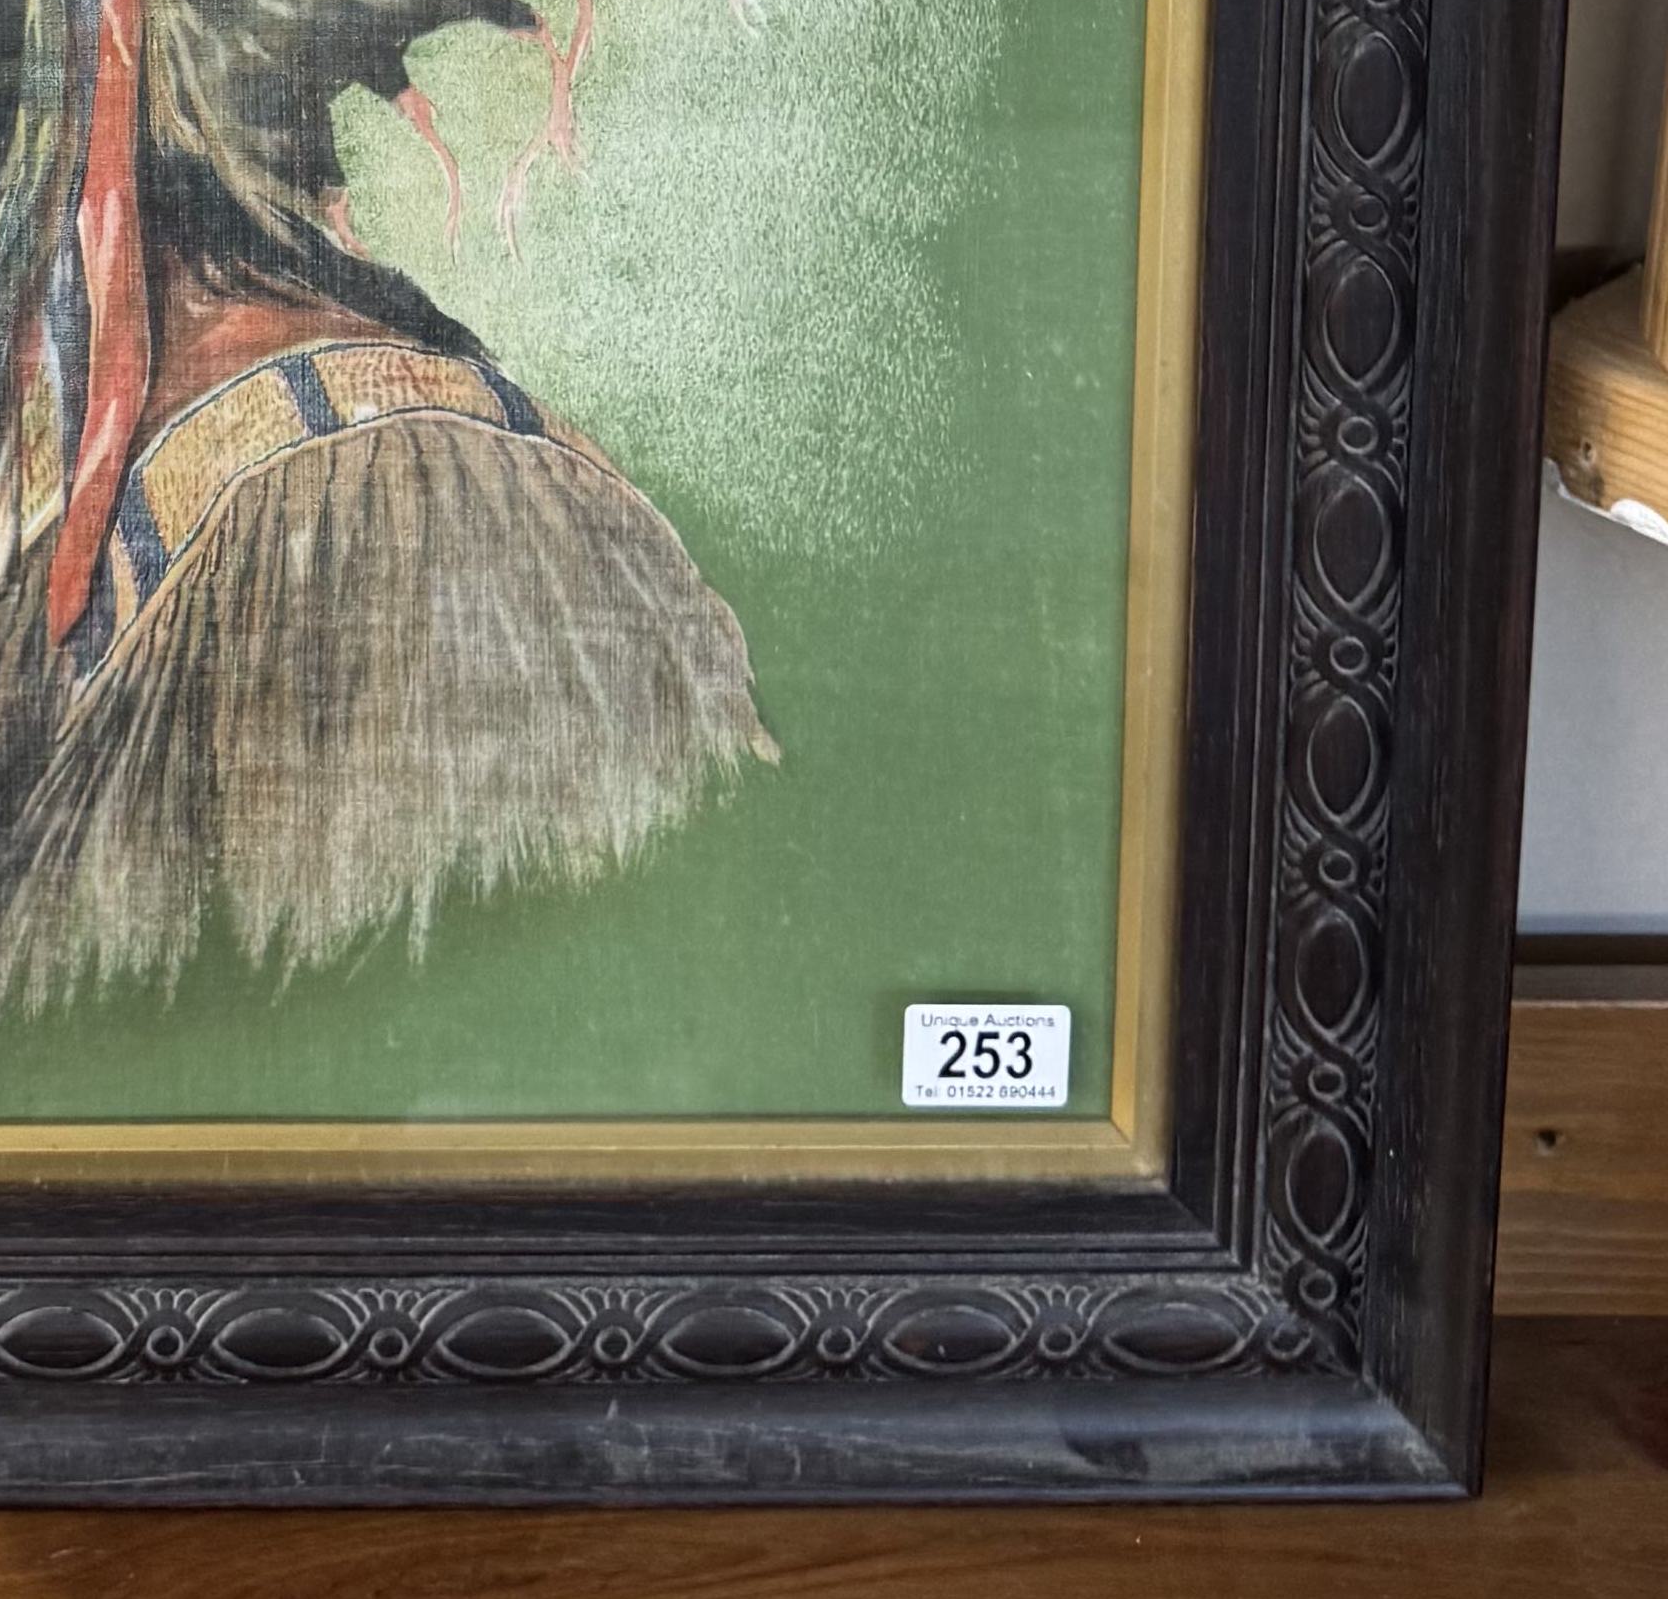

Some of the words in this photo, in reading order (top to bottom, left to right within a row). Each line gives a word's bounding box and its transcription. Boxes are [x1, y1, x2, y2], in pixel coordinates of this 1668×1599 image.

[921, 1013, 978, 1031] Unique
[984, 1013, 1055, 1028] Auctions
[938, 1031, 1033, 1079] 253
[947, 1084, 994, 1099] 01522
